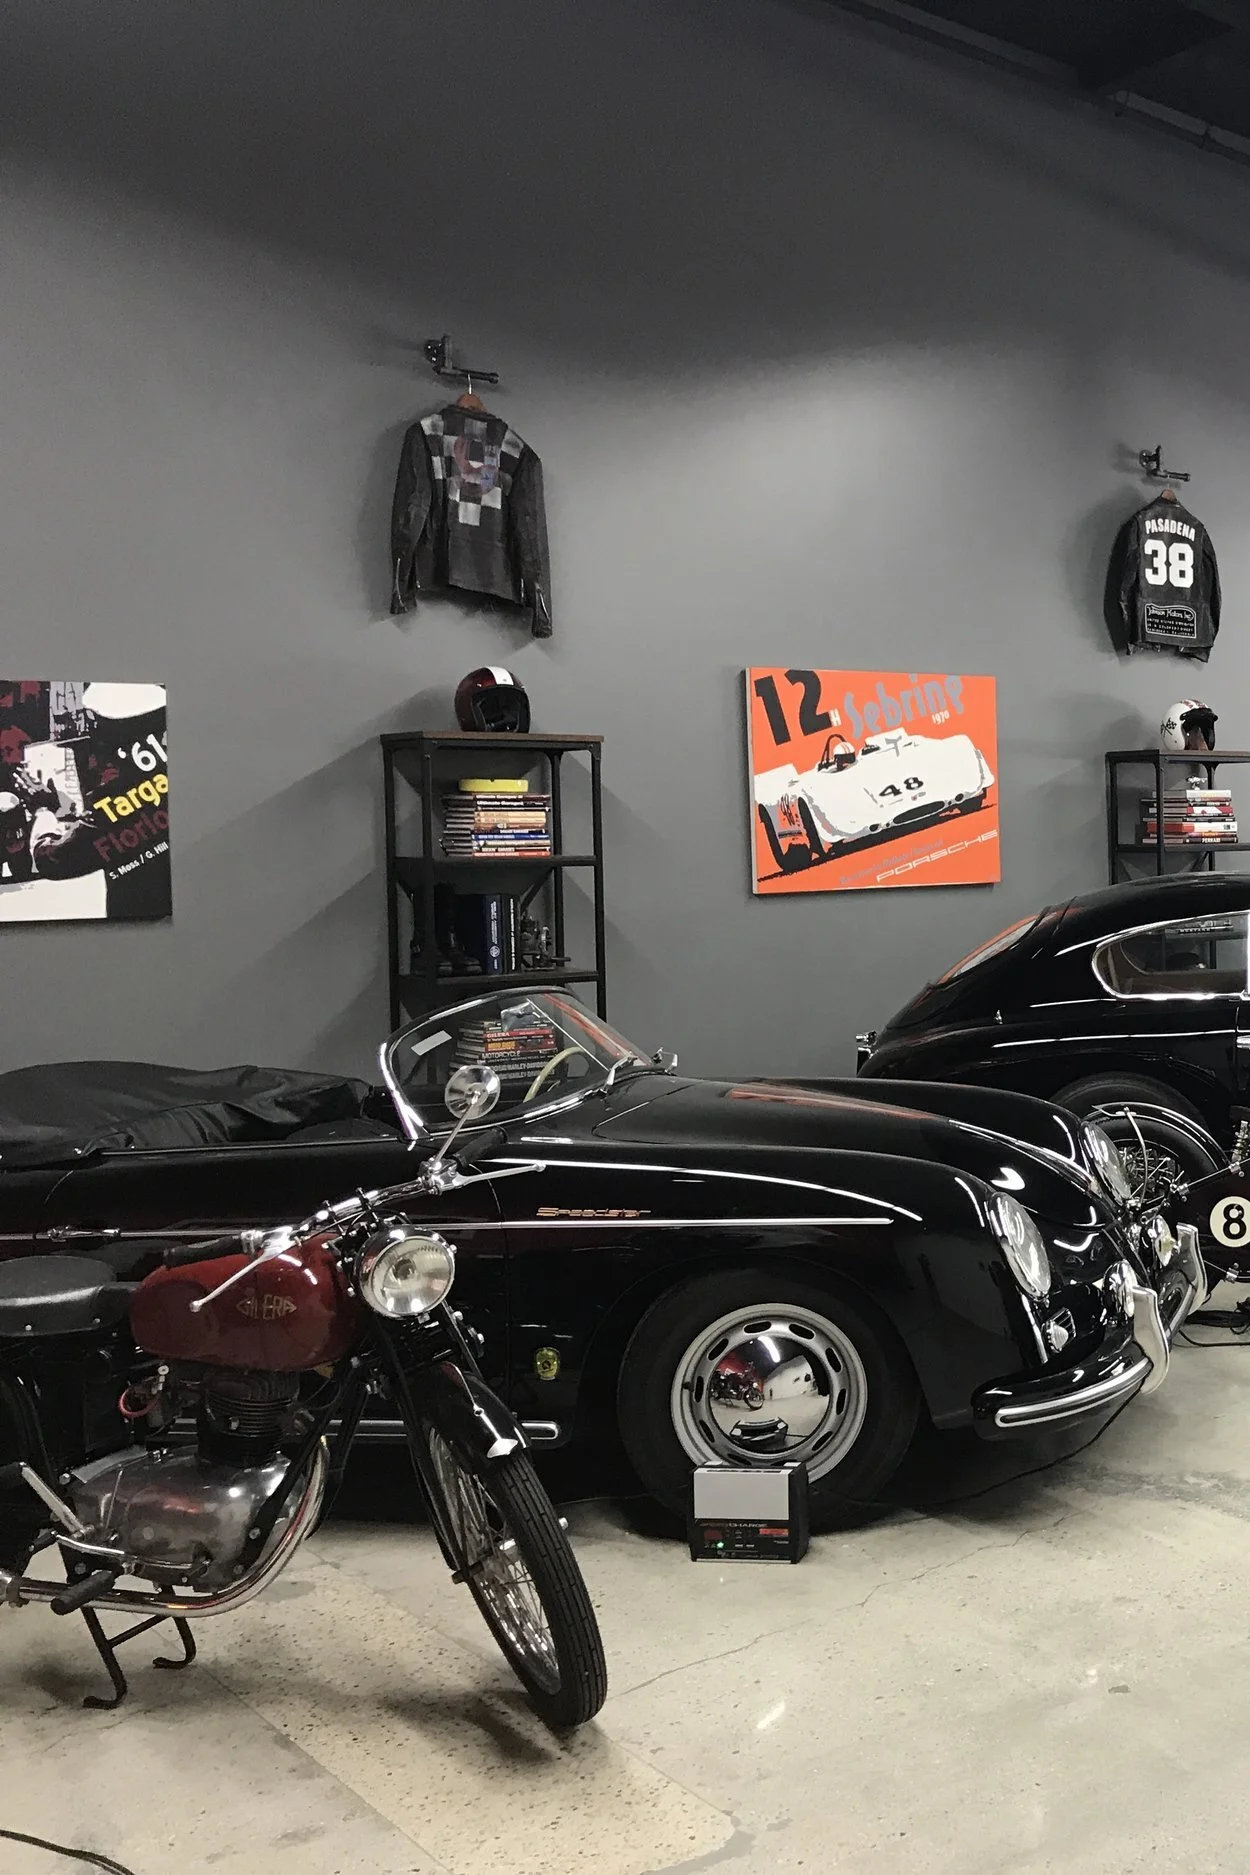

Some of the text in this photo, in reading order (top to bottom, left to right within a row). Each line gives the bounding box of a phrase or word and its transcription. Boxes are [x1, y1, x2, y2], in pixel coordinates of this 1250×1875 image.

[1145, 518, 1196, 542] PASADENA
[1144, 539, 1194, 589] 38
[844, 674, 964, 740] Sebring
[931, 710, 951, 726] 1970
[93, 773, 168, 823] Targa
[879, 777, 924, 798] 48
[93, 810, 168, 862] Florio
[118, 860, 140, 876] Moss
[154, 841, 168, 854] Hill
[876, 829, 999, 883] PORSCHE
[482, 1050, 521, 1058] MOTORCYCLE
[1223, 1203, 1247, 1240] 8
